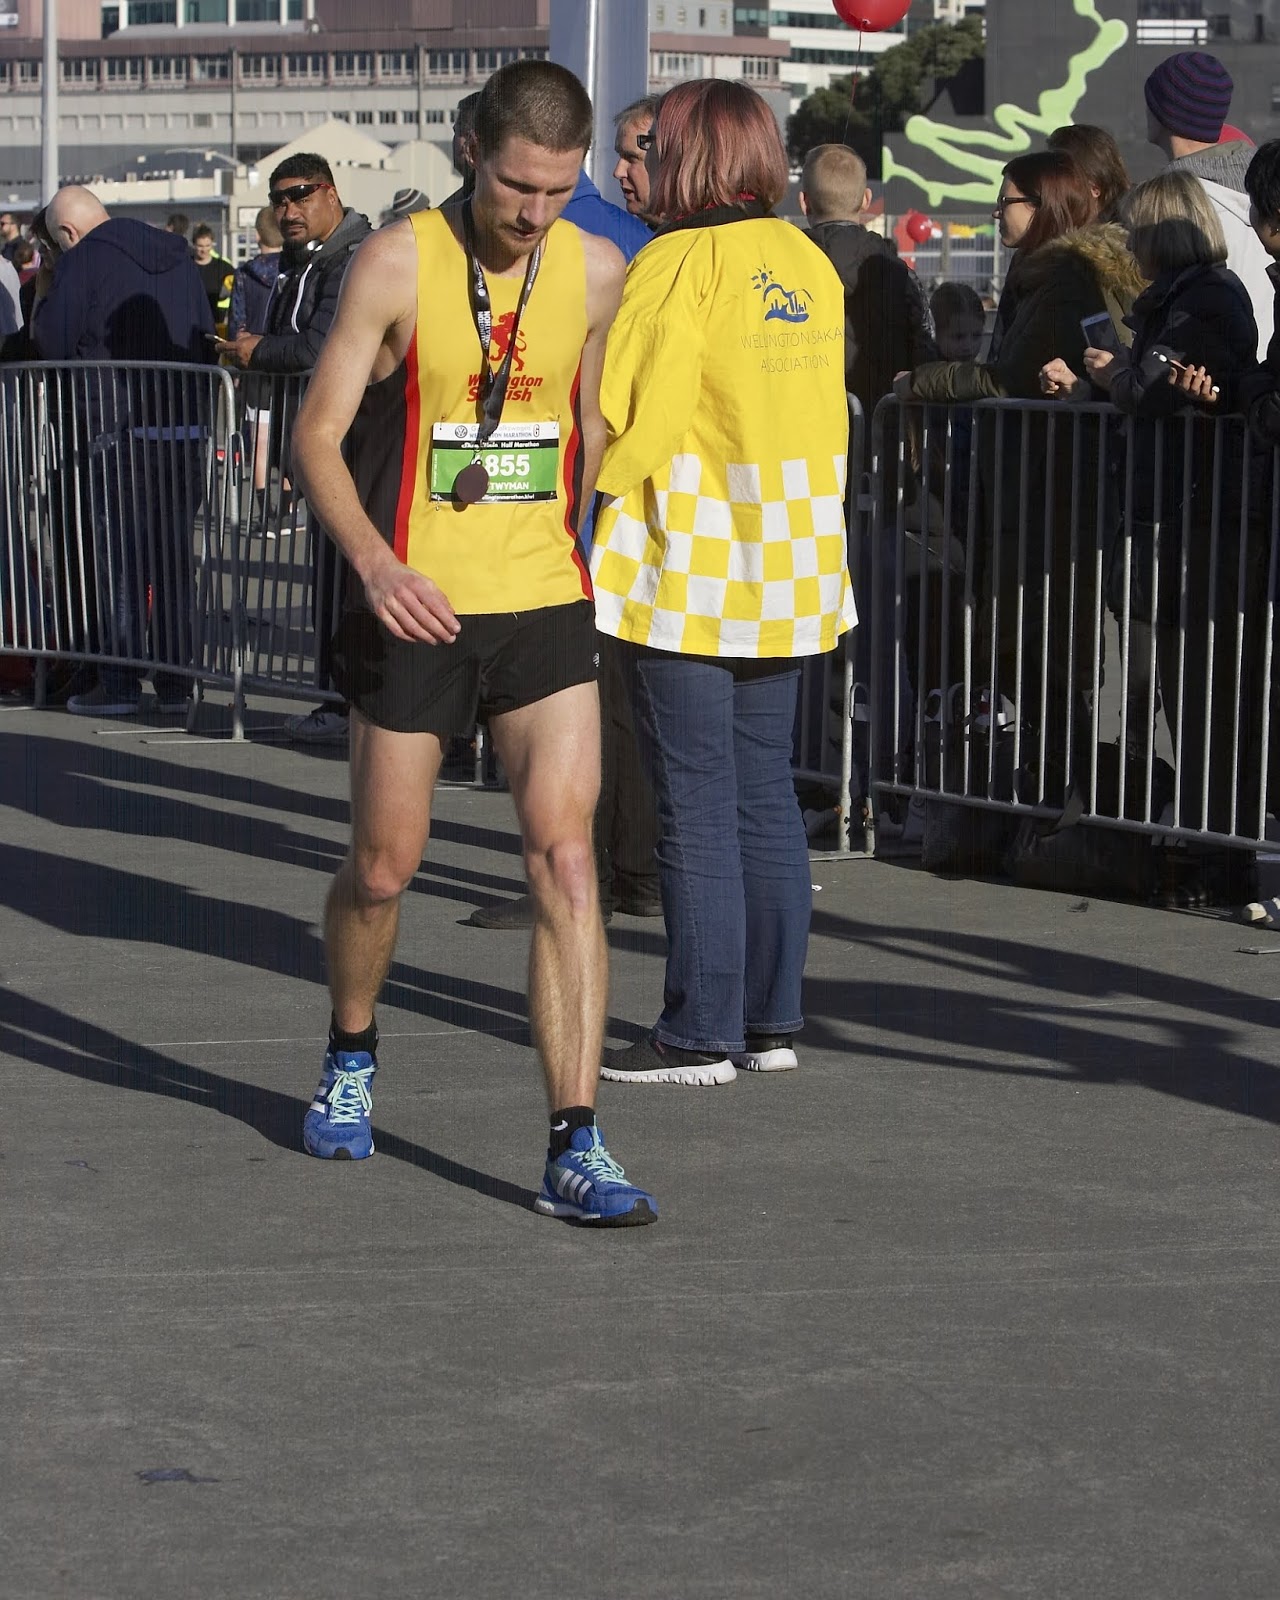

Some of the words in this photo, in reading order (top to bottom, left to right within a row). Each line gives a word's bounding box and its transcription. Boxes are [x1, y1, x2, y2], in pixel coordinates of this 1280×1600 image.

[811, 326, 844, 345] SAKA
[761, 354, 830, 373] ASSOCIATION
[490, 481, 529, 490] TWYMAN
